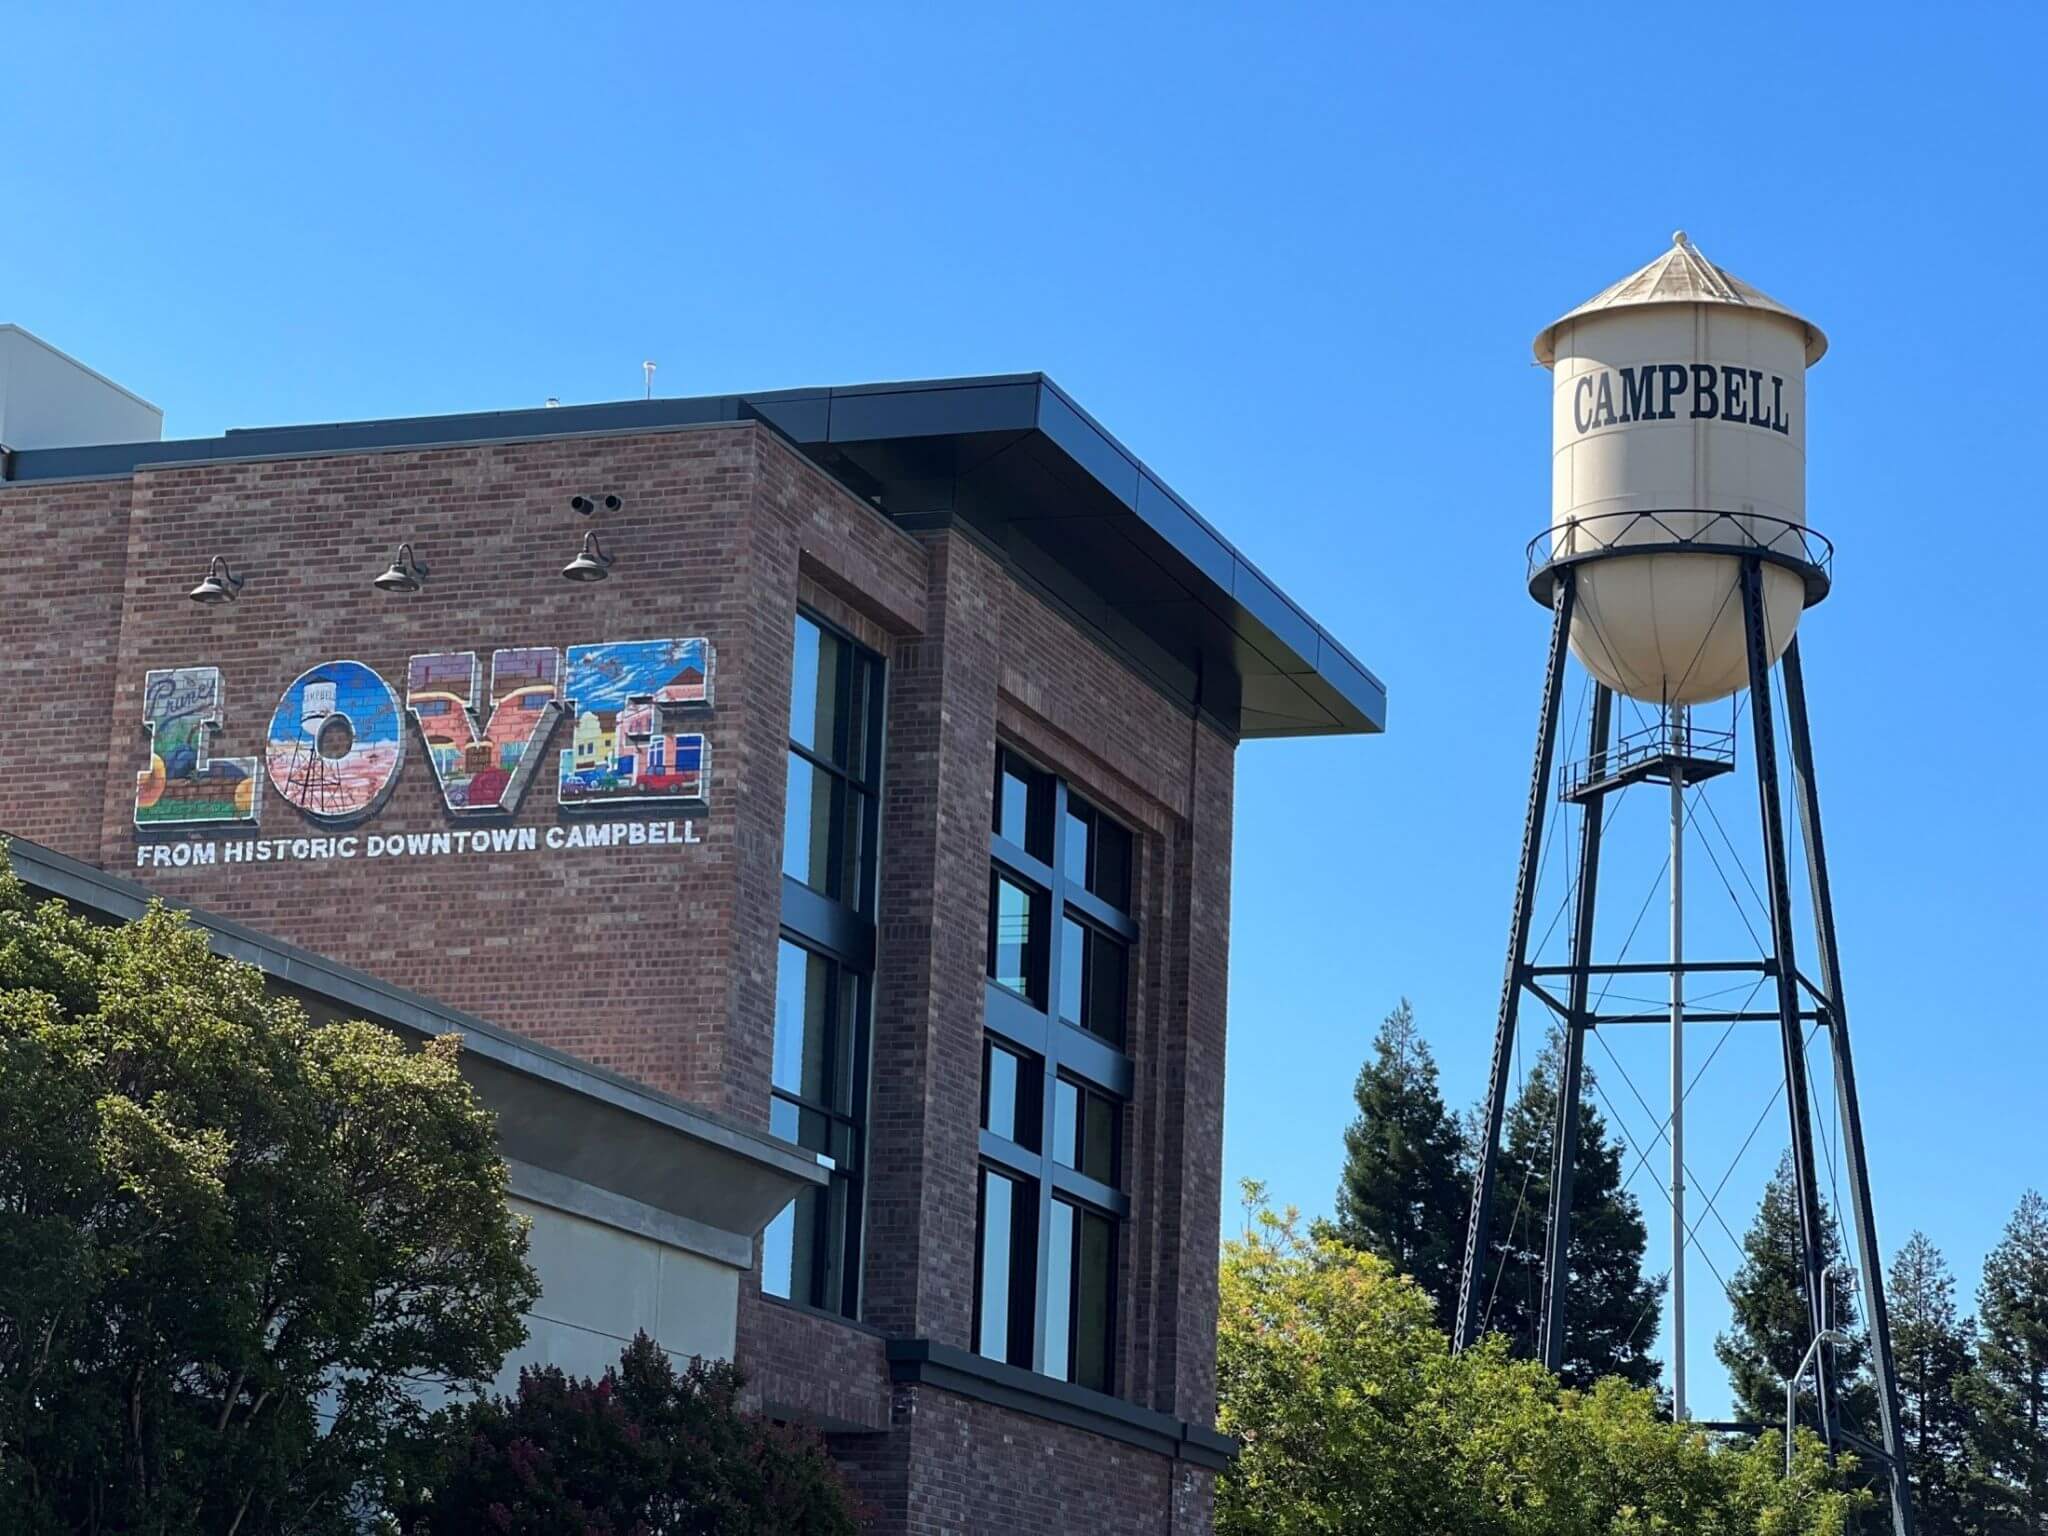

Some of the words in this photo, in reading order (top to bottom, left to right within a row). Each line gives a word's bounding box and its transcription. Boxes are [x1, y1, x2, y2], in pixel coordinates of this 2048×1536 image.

[1574, 363, 1789, 434] CAMPBELL
[134, 637, 716, 832] LOVE
[136, 842, 216, 867] FROM
[223, 837, 357, 863] HISTORIC
[366, 827, 536, 857] DOWNTOWN
[546, 821, 700, 848] CAMPBELL
